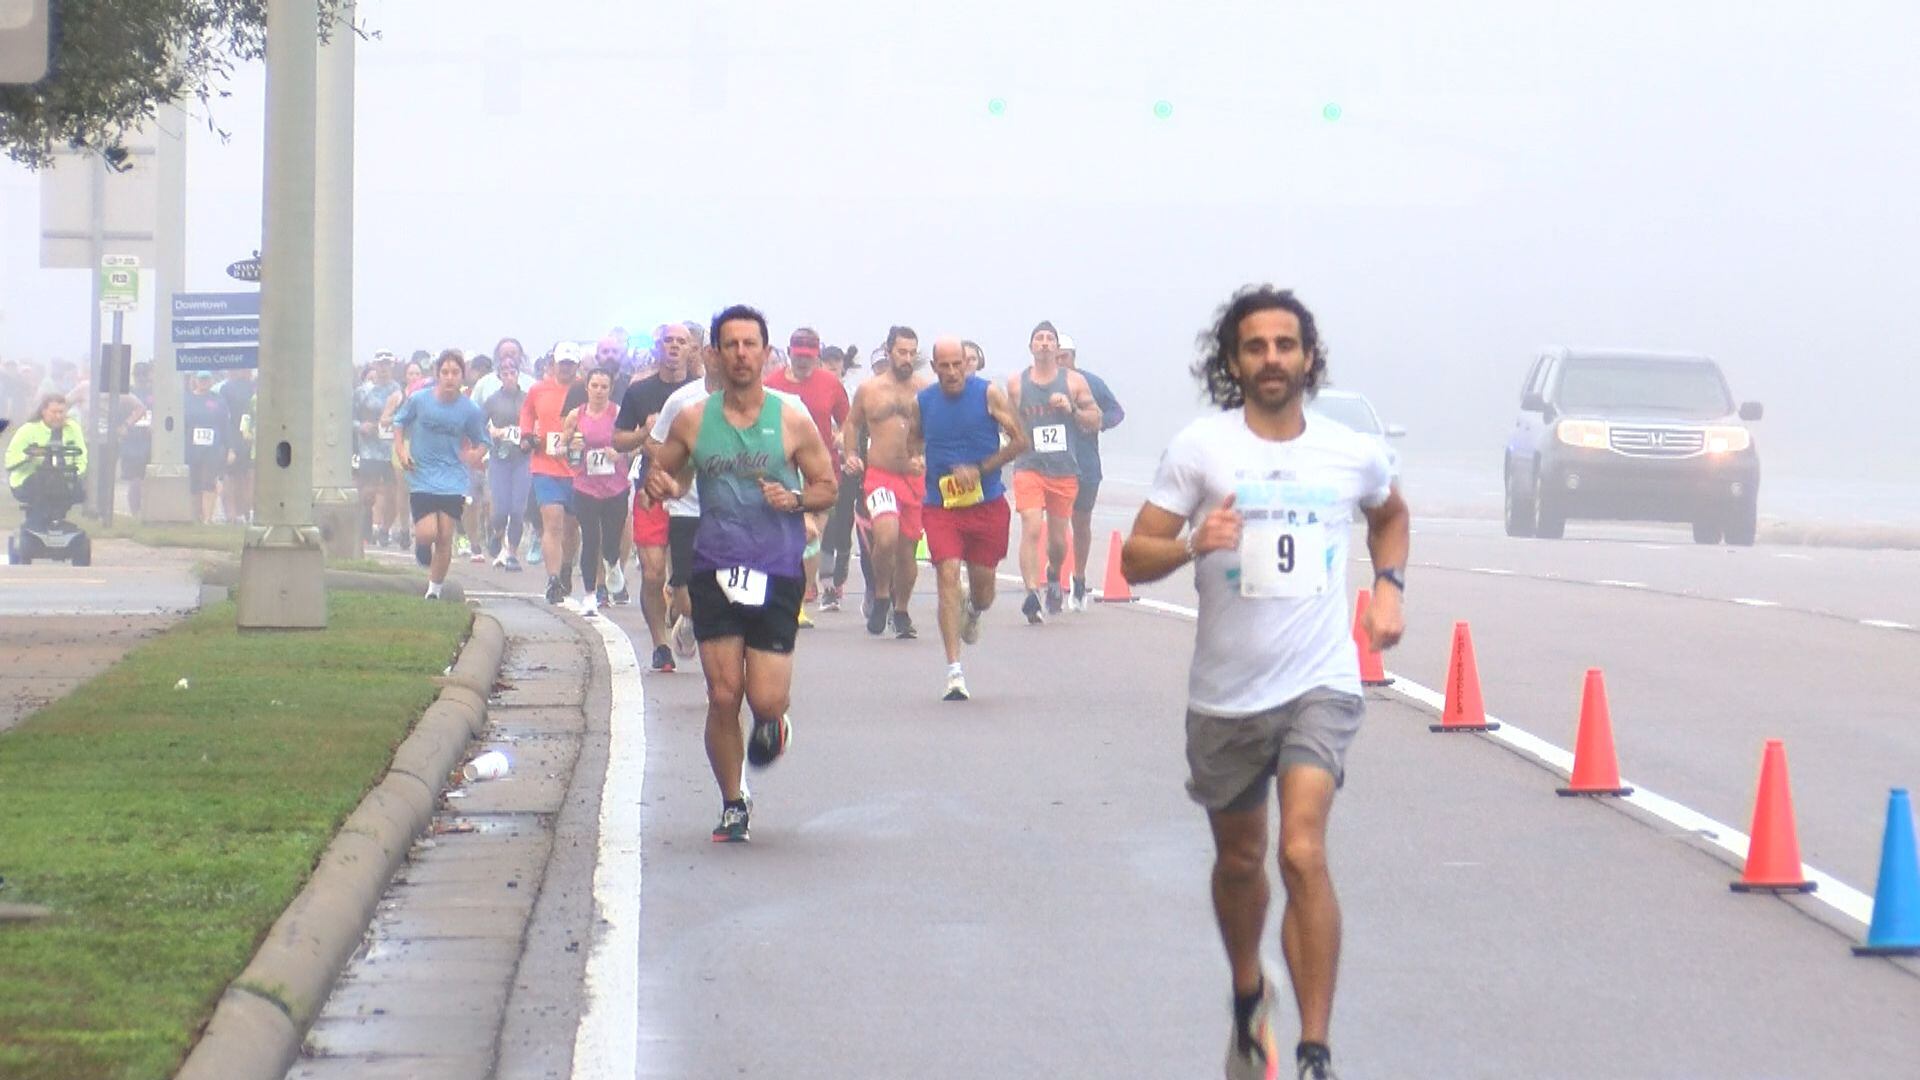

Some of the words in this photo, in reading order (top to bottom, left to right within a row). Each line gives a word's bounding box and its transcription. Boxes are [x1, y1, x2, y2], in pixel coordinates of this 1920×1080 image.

[233, 270, 260, 278] DIST
[175, 301, 228, 310] Downtown
[175, 326, 200, 336] Small
[202, 326, 224, 335] Craft
[179, 354, 212, 364] Visitors
[214, 353, 244, 363] Center
[1042, 428, 1058, 443] 52
[592, 451, 605, 466] 27
[1277, 534, 1295, 573] 9
